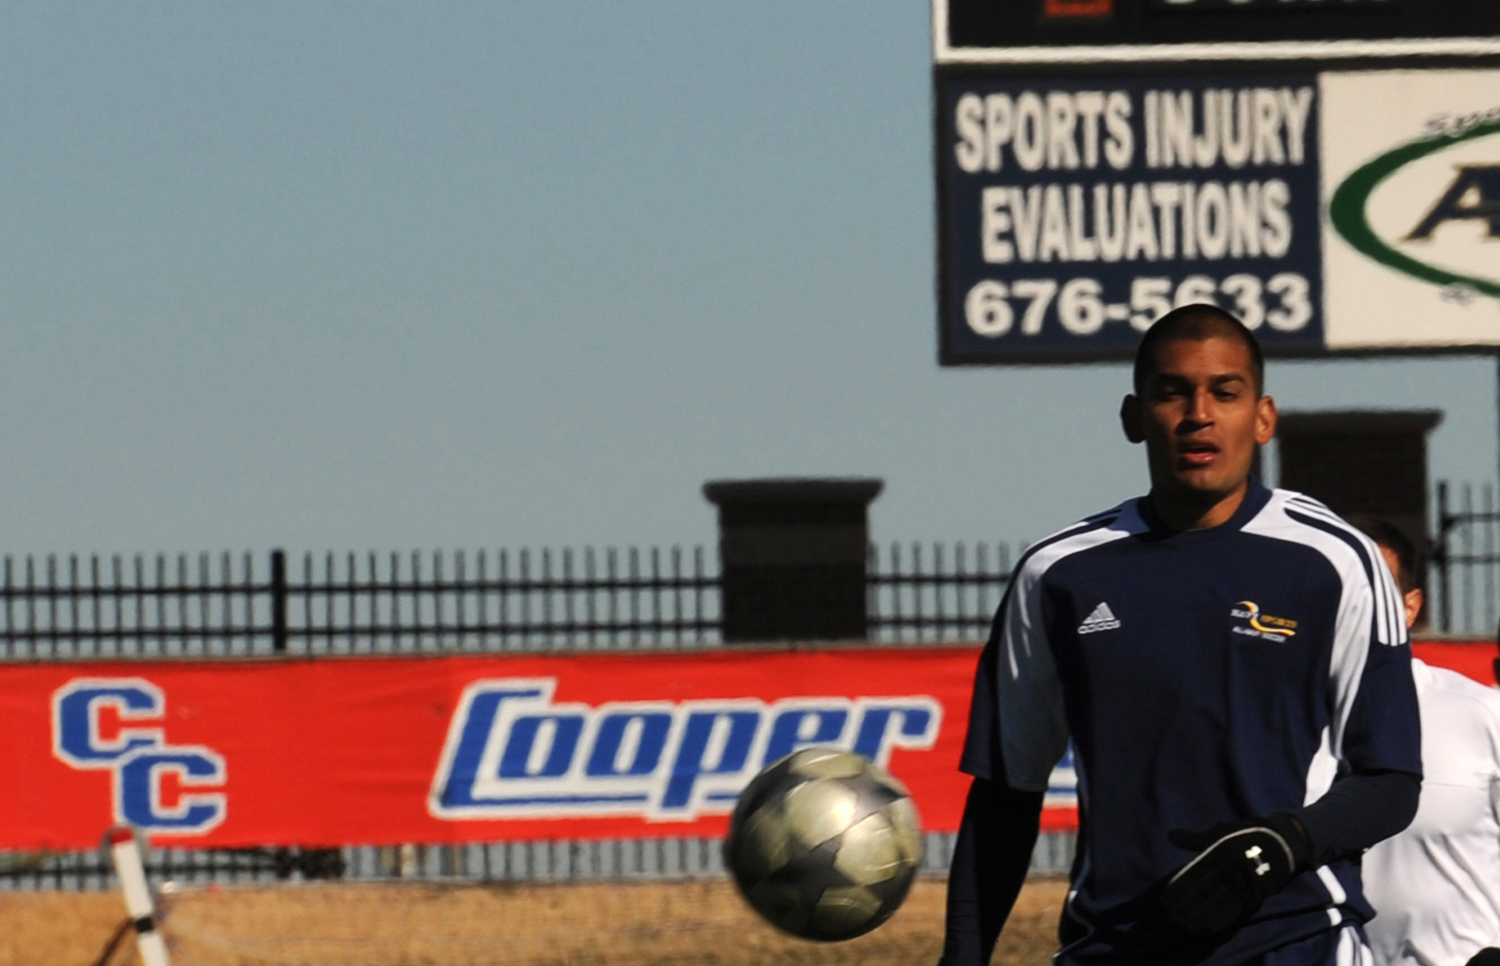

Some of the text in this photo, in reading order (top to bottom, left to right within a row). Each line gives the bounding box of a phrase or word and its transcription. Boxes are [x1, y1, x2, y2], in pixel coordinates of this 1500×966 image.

[955, 87, 1313, 172] SPORTS INJURY
[981, 180, 1292, 263] EVALUATIONS
[428, 677, 942, 822] Cooper
